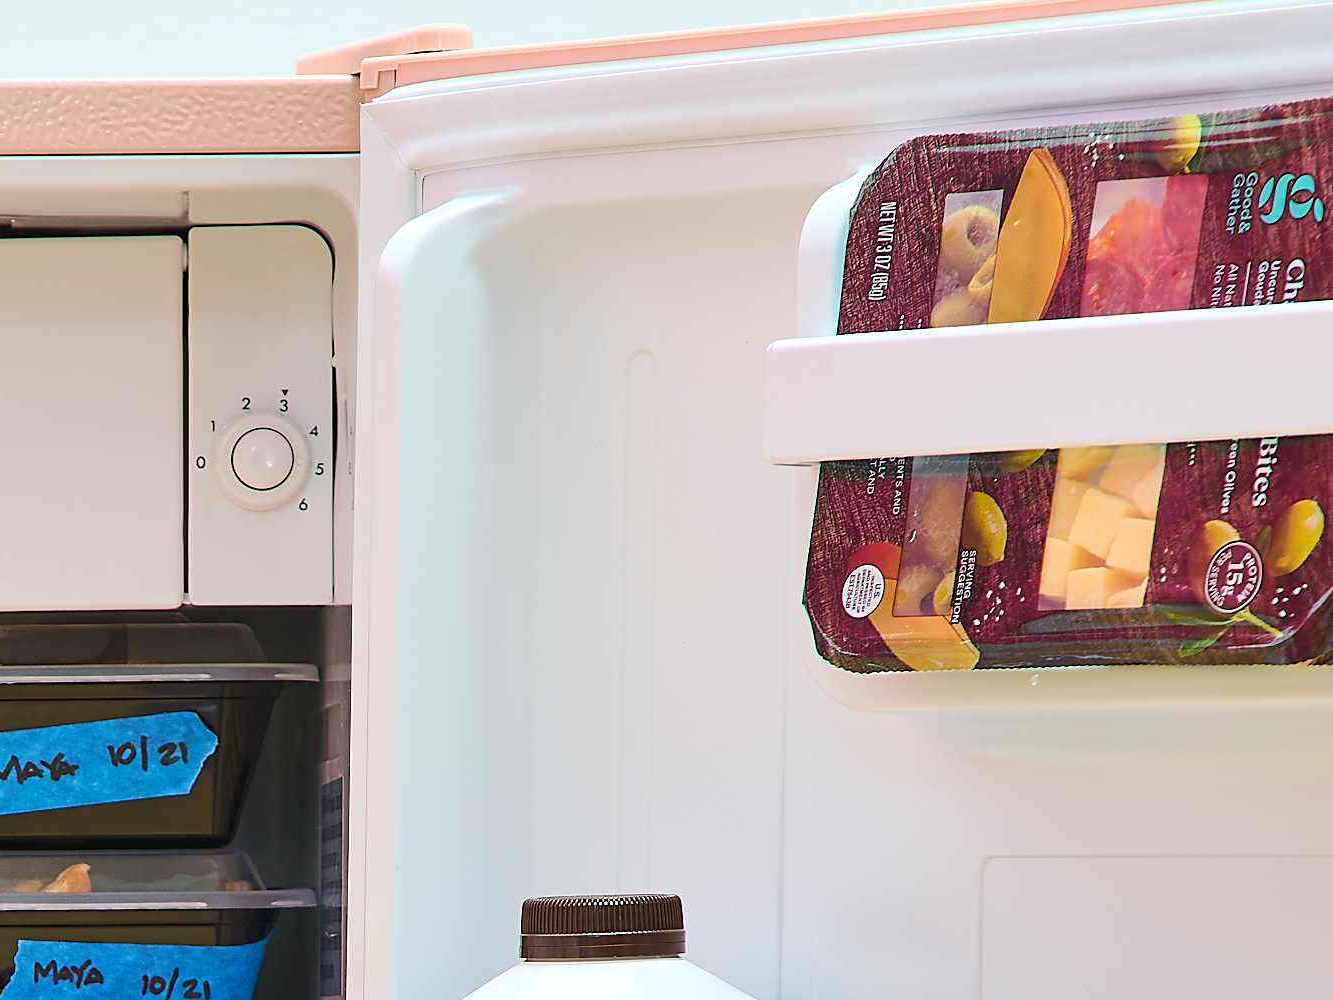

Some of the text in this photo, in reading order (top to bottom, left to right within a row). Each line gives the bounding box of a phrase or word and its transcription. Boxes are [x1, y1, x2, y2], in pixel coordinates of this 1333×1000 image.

[1226, 173, 1245, 234] Gather
[869, 201, 897, 300] NET WT 3 OZ (85g)
[1214, 265, 1225, 283] No
[1228, 264, 1239, 280] All
[242, 398, 250, 409] 2
[280, 399, 288, 412] 3
[211, 420, 215, 432] 1
[309, 425, 318, 436] 4
[196, 456, 206, 469] 0
[315, 463, 324, 475] 5
[1252, 437, 1279, 508] Bites
[866, 469, 877, 495] AND
[1221, 470, 1237, 514] Olives
[299, 498, 308, 511] 6
[892, 490, 903, 515] AND
[951, 550, 969, 624] SUGGESTION
[963, 550, 977, 599] SERVING
[1220, 562, 1245, 596] 15g
[1237, 552, 1258, 604] PROTEIN
[107, 735, 188, 772] 10/21
[141, 967, 211, 1000] 10/21
